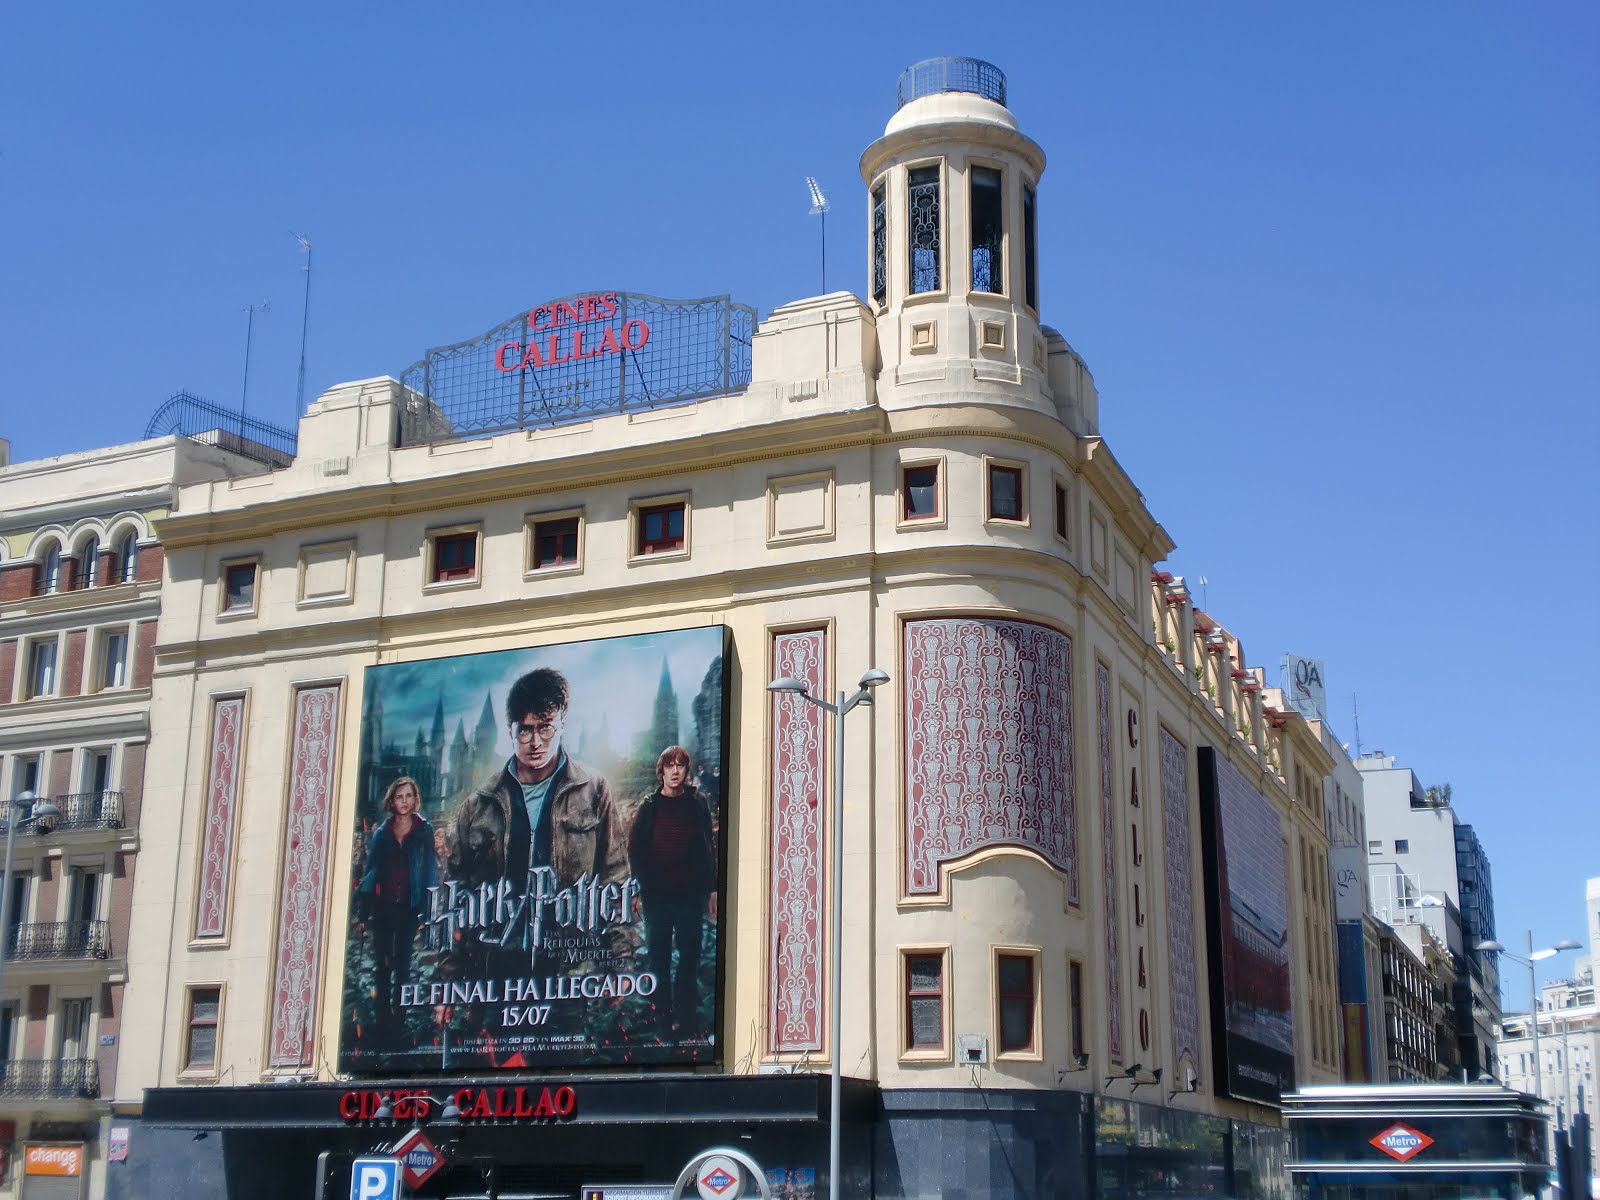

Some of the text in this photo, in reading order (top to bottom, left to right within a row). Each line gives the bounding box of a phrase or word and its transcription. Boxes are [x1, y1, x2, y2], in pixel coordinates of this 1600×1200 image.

[528, 292, 617, 331] CINES
[495, 319, 650, 373] CALLAO
[418, 866, 641, 956] Harry Potter
[564, 948, 612, 963] MUERTE
[400, 973, 657, 1006] EL FINAL HA LLEGADO
[500, 1006, 551, 1027] 15/07
[340, 1086, 576, 1120] CINES CALLAO
[1386, 1136, 1417, 1147] Metro
[30, 1147, 77, 1166] change
[408, 1153, 433, 1166] Metro
[359, 1167, 387, 1200] P
[709, 1177, 728, 1186] Metro
